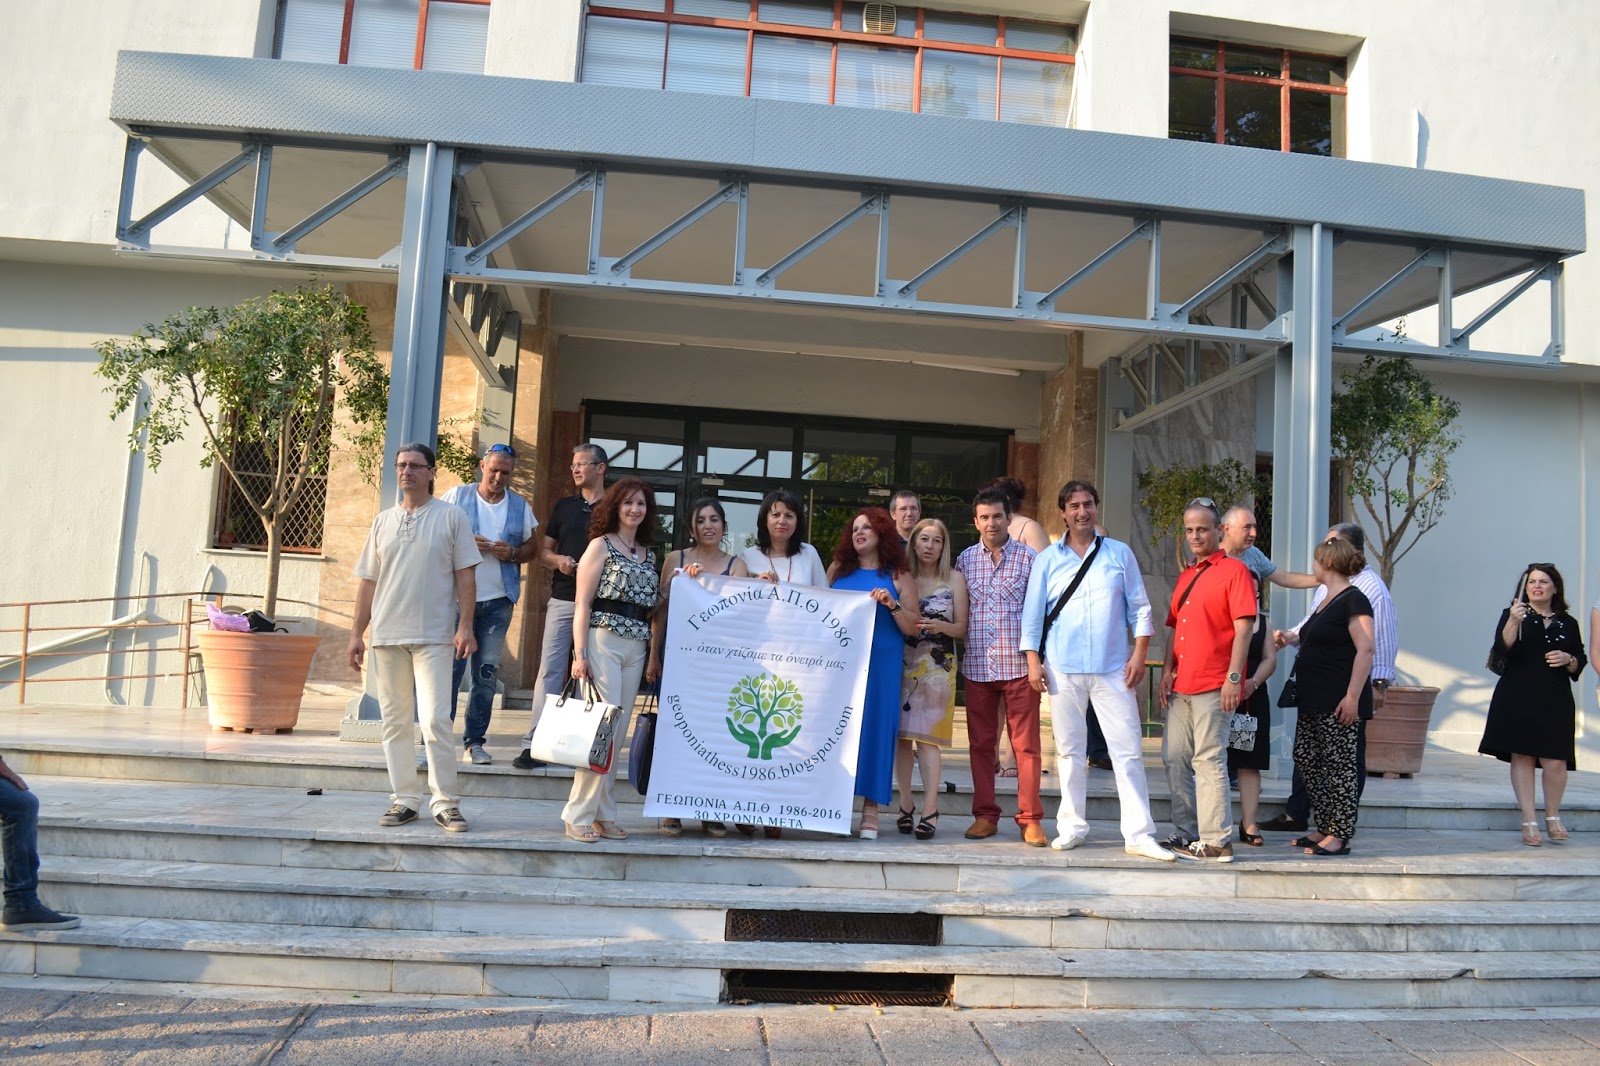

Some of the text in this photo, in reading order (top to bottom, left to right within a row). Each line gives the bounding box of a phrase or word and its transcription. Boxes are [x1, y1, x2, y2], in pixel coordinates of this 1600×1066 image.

[687, 586, 853, 648] Γεωπονία Α.Π.Θ 1986
[697, 641, 724, 654] όταν
[725, 646, 767, 661] χτίζαμε
[770, 653, 783, 662] τα
[786, 652, 823, 668] όνειρά
[824, 660, 847, 671] μας
[667, 694, 854, 781] geoponiathess1986.blogspot.com
[656, 793, 842, 820] ΓΕΩΠΟΝΙΑ Α.Π.Θ 1986-2016
[694, 809, 804, 829] 30 ΧΡΟΝΙΑ ΜΕΤΑ
